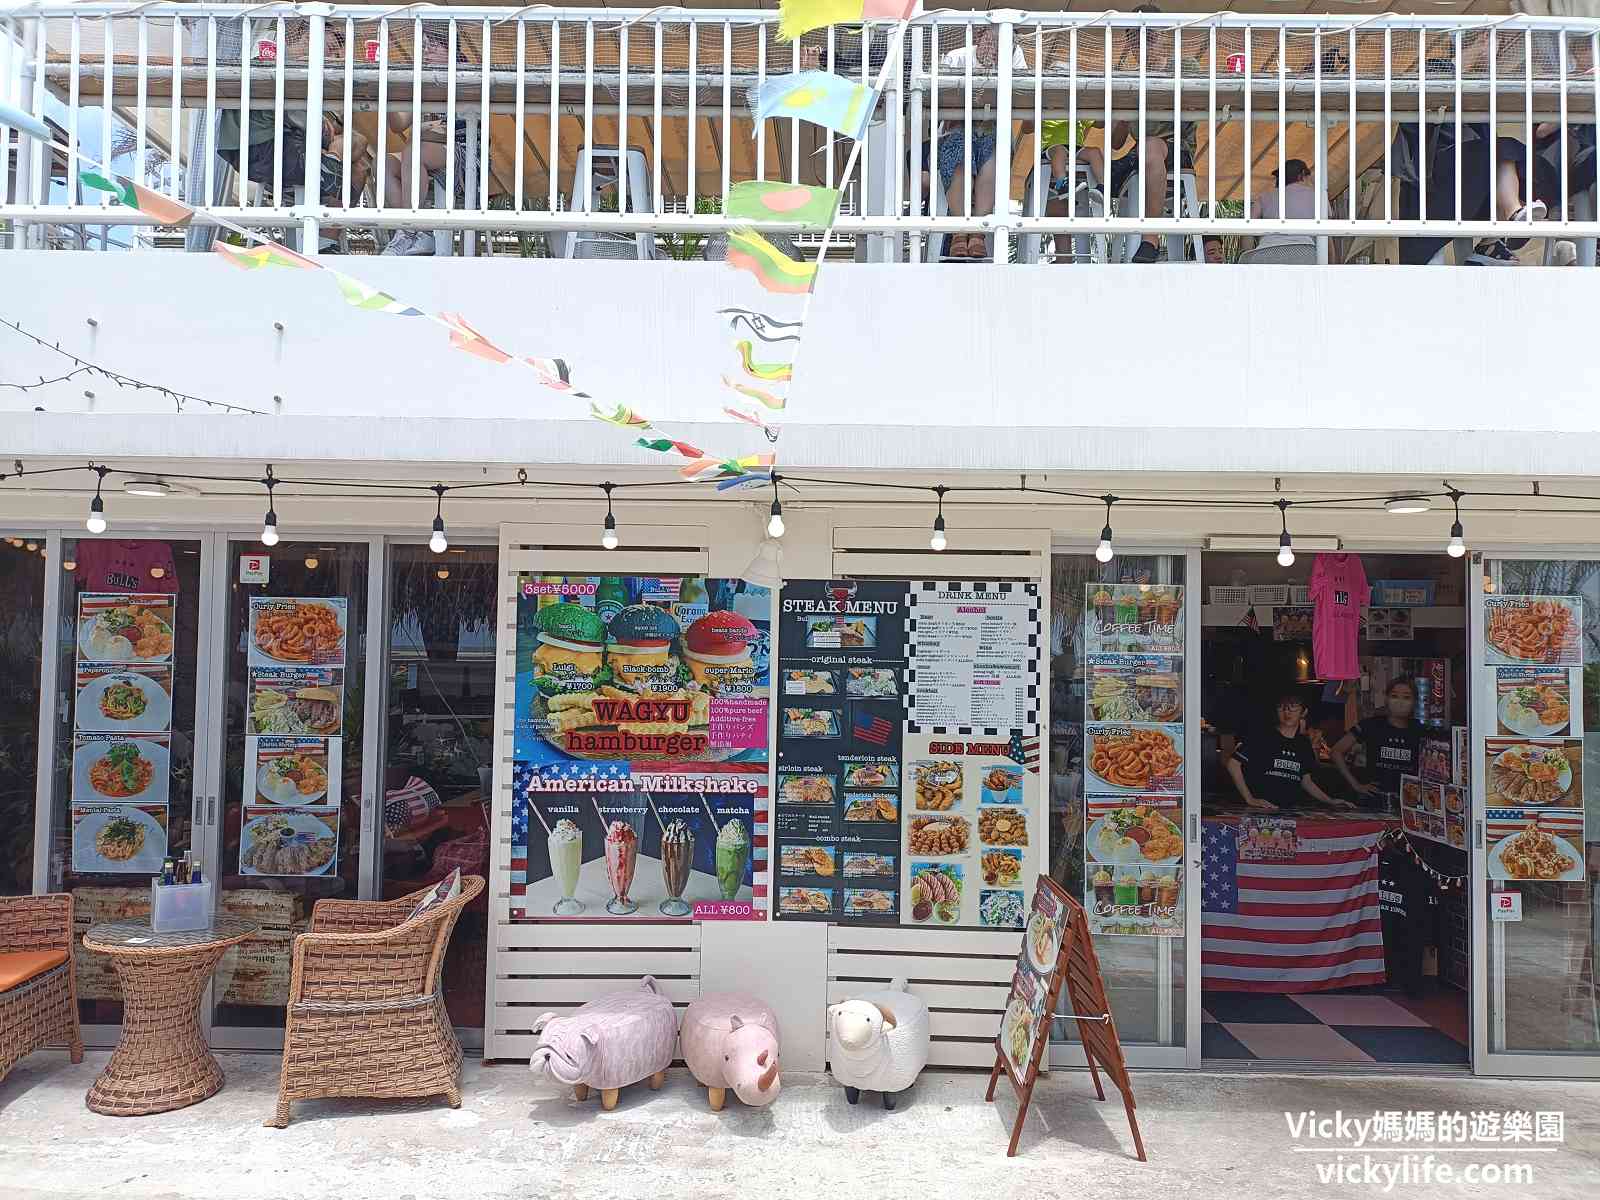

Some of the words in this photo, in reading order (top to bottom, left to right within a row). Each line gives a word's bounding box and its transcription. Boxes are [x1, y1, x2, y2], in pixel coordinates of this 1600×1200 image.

[938, 591, 973, 600] DRINK
[975, 592, 1007, 601] MENU
[783, 600, 842, 613] STEAK
[844, 601, 898, 614] MENU
[811, 656, 846, 664] original
[553, 663, 577, 673] Luigi
[623, 665, 646, 674] Black
[647, 666, 670, 674] bomb
[704, 668, 729, 676] super
[566, 682, 594, 691] ¥1700
[651, 684, 678, 693] ¥1900
[725, 684, 753, 693] ¥1800
[593, 701, 691, 722] WAGYU
[567, 733, 708, 754] hamburger
[929, 743, 964, 754] SIDE
[966, 743, 1010, 755] MENU
[838, 754, 875, 762] tenderloin
[803, 765, 823, 773] steak
[526, 776, 635, 793] American
[640, 776, 759, 793] Milkshake
[599, 806, 648, 815] strawberry
[658, 806, 700, 814] chocolate
[840, 835, 861, 843] steak
[694, 905, 717, 914] ALL
[720, 905, 750, 915] ¥800
[1094, 901, 1142, 915] COFFEE
[1142, 902, 1177, 916] TIME
